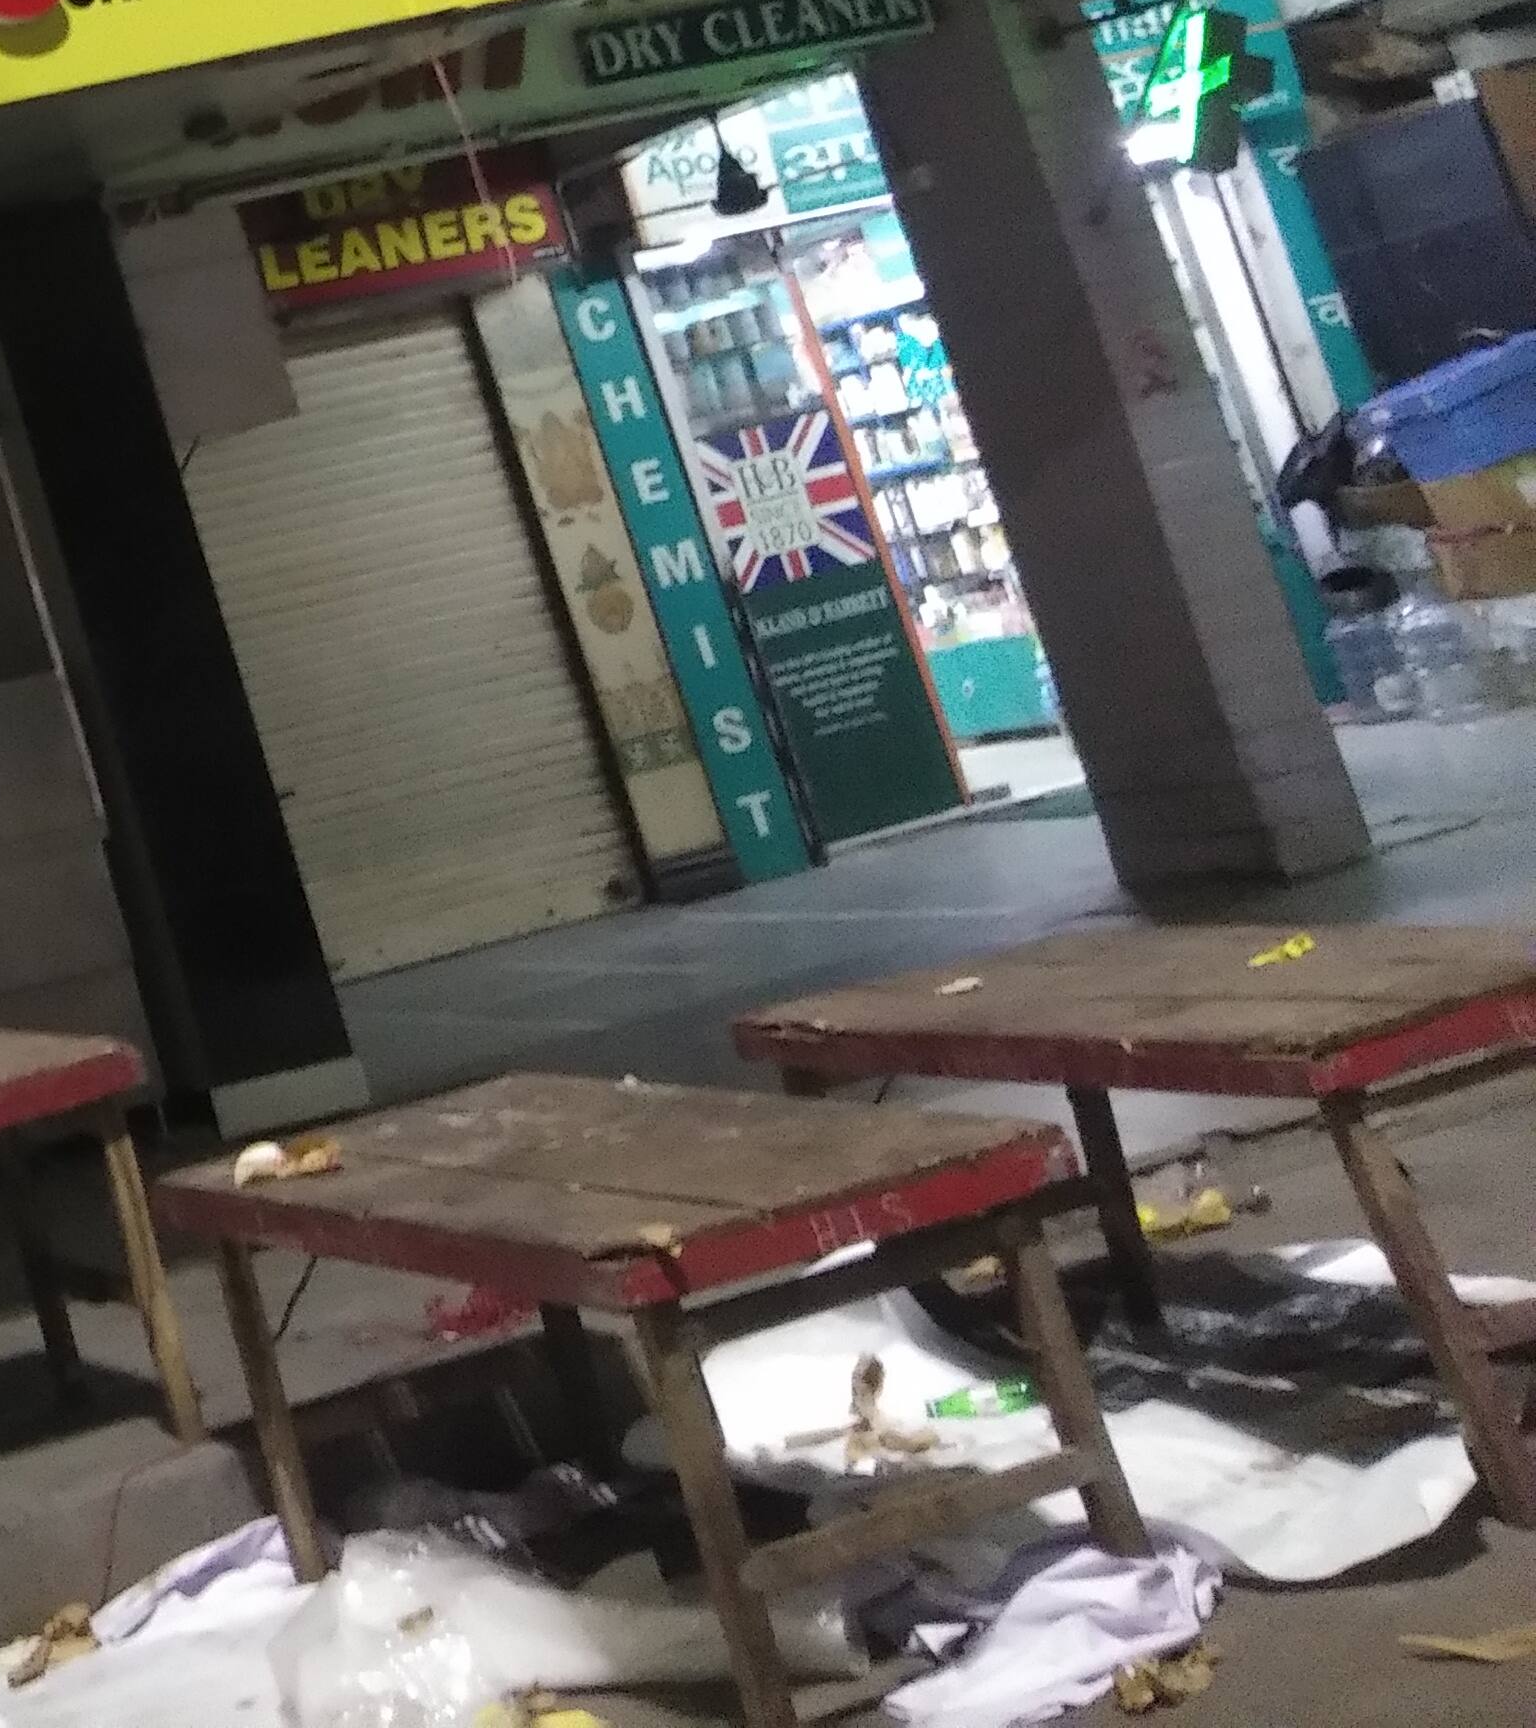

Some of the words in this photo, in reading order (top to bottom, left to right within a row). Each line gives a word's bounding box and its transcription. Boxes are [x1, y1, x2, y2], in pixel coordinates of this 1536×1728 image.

[588, 21, 687, 76] DRY
[647, 146, 758, 198] Apoo
[759, 522, 812, 551] 1870
[576, 300, 773, 838] CHEMIST
